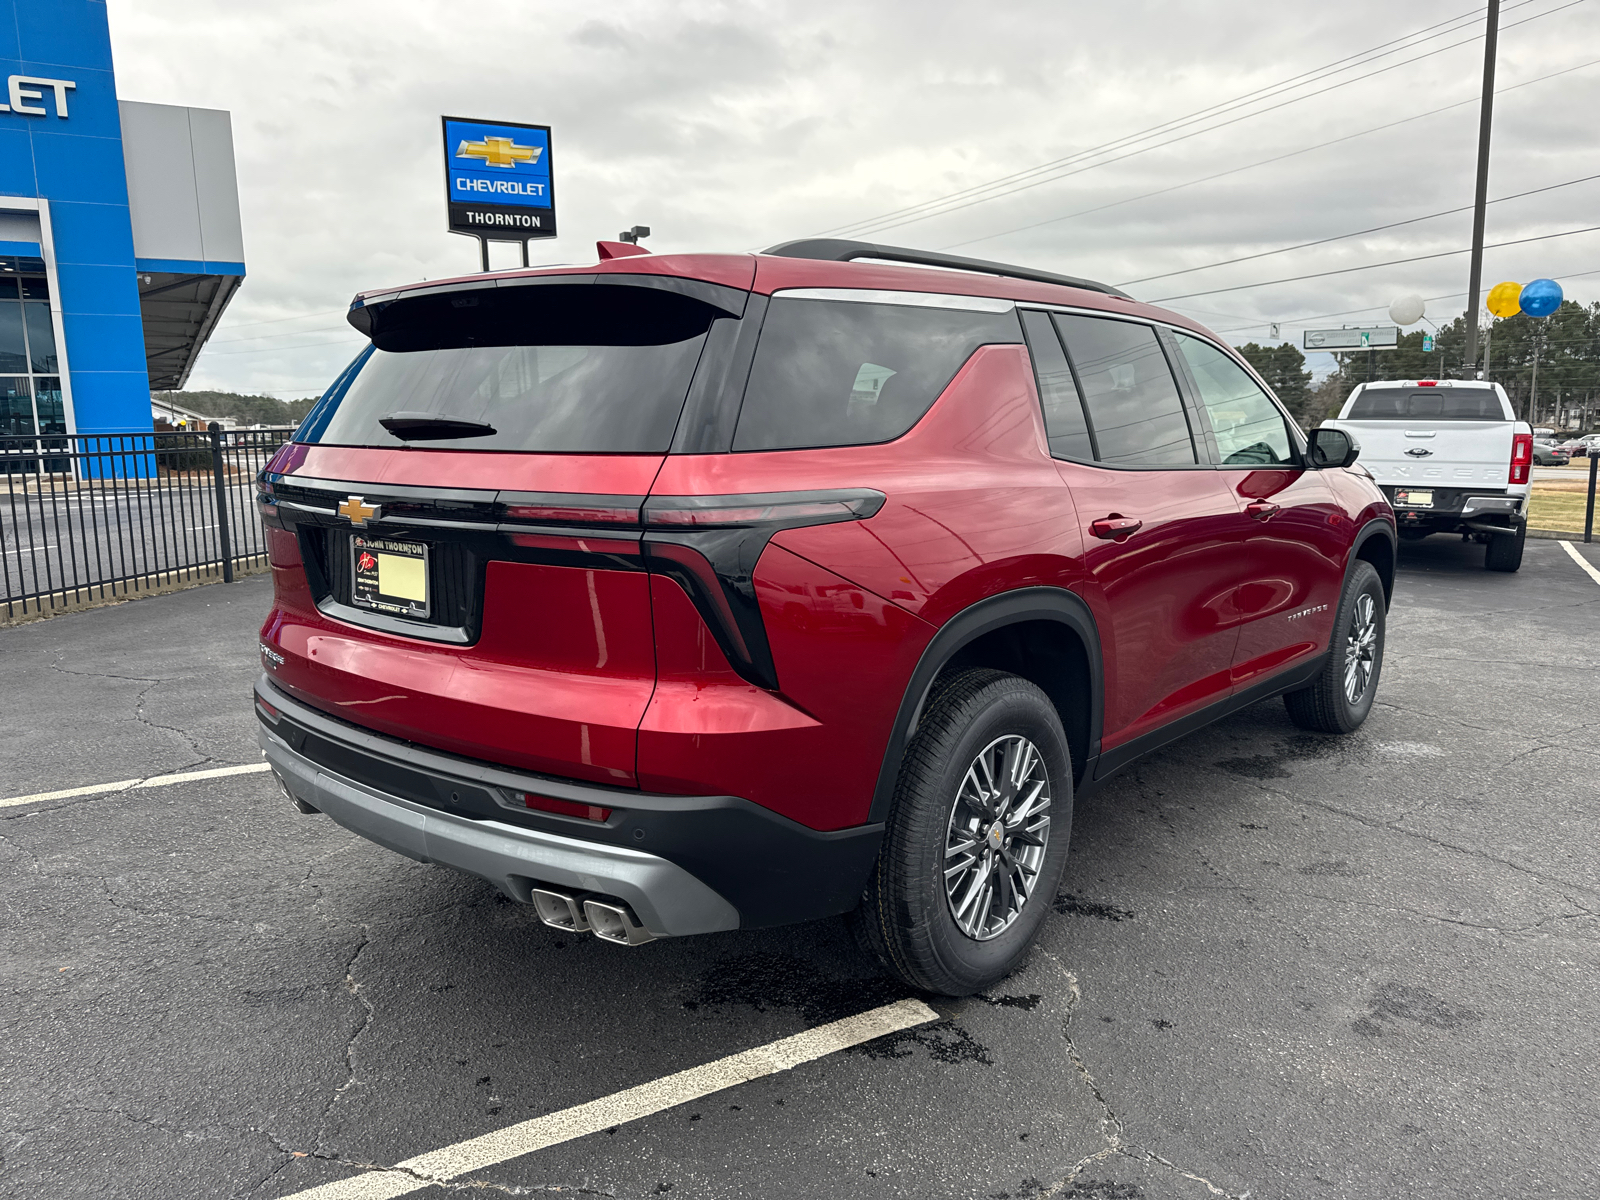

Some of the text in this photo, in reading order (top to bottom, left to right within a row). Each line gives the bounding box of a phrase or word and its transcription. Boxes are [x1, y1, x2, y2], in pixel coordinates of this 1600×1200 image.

[456, 177, 545, 196] CHEVROLET
[466, 211, 541, 228] THORNTON
[1367, 465, 1503, 479] ANGER
[366, 540, 423, 555] JOHN THORNTON
